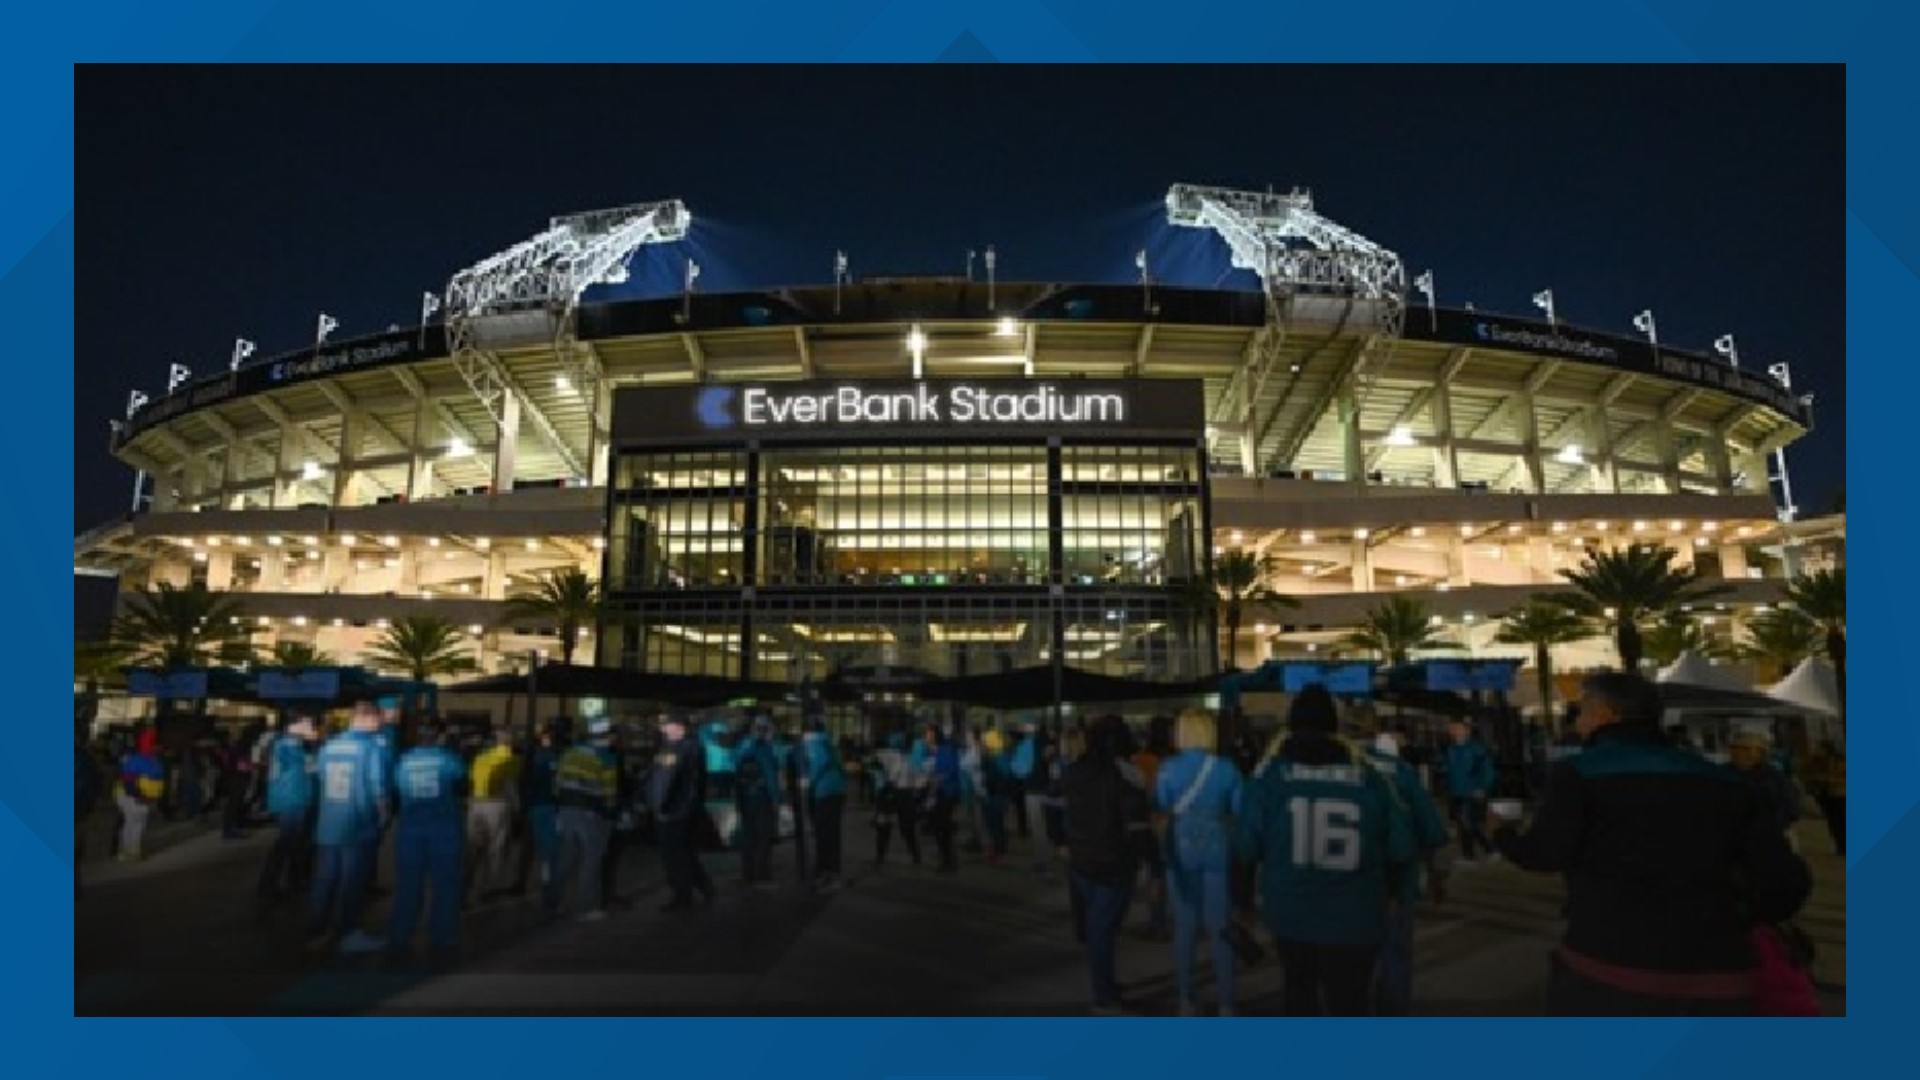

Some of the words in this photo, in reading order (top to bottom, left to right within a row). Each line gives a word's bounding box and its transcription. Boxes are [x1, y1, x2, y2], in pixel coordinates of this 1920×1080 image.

[743, 382, 940, 424] EverBank
[948, 384, 1124, 423] Stadium
[1288, 796, 1361, 871] 16
